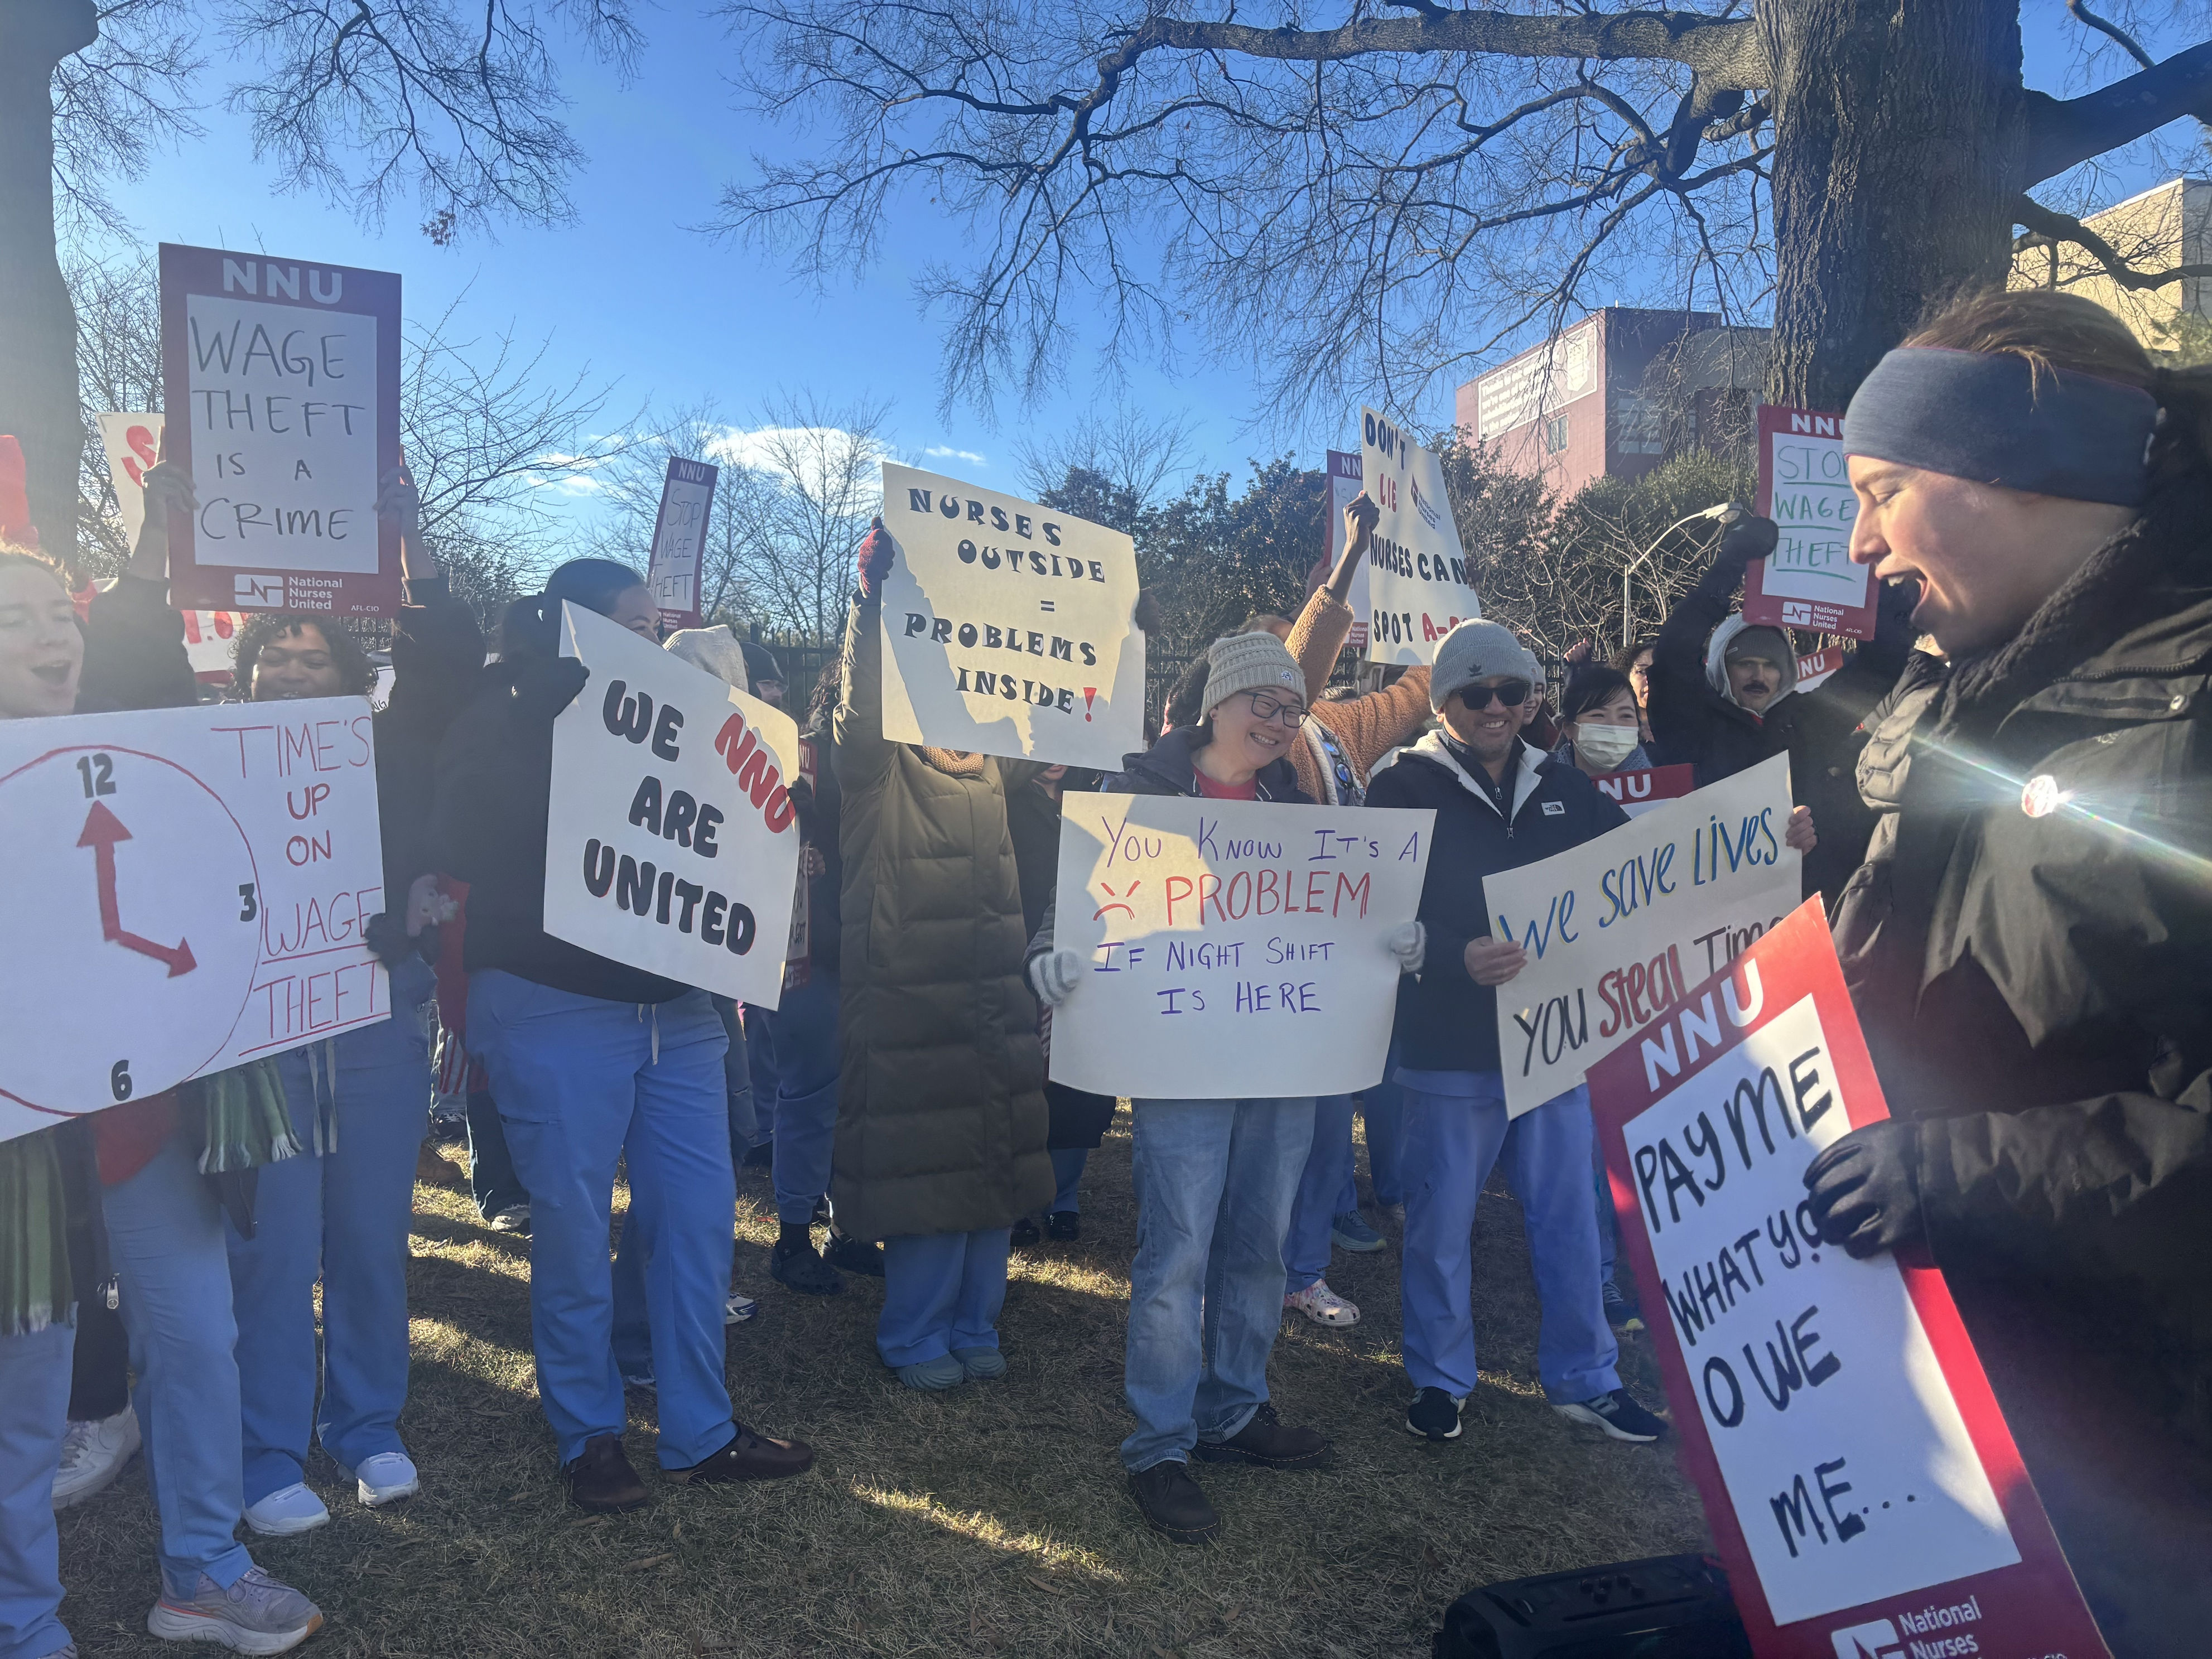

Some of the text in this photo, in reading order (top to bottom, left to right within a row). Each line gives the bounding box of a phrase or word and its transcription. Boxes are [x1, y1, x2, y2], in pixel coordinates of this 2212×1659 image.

[223, 258, 343, 305] NNU
[190, 316, 348, 387] WAGE
[192, 390, 366, 437] THEFT
[1365, 413, 1405, 471] DON'T
[217, 453, 312, 480] IS A
[678, 461, 705, 483] NNU
[1342, 456, 1362, 478] NN
[667, 488, 701, 528] STOP
[1380, 473, 1396, 513] LIE
[1775, 492, 1855, 521] WAGE
[201, 498, 354, 540] CRIME
[908, 489, 1061, 546] NURSES
[1418, 508, 1435, 529] United
[659, 530, 692, 558] WAGE
[958, 539, 1105, 583] OUTSIDE
[1370, 533, 1468, 585] NURSES CAN
[289, 576, 343, 588] National
[289, 588, 332, 599] Nurses
[649, 563, 693, 601] THEFT
[289, 599, 332, 610] United
[1813, 613, 1838, 623] Nurses
[1814, 605, 1844, 616] National
[904, 613, 1096, 665] PROBLEMS
[1374, 609, 1413, 644] SPOT
[1813, 620, 1837, 630] United
[1797, 653, 1825, 679] NU
[955, 667, 1097, 722] INSIDE!
[603, 679, 684, 762] WE
[211, 716, 371, 778] TIME'S
[76, 753, 117, 798] 12
[715, 713, 796, 833] NNU
[1599, 774, 1651, 800] NU
[288, 783, 330, 820] UP
[628, 775, 724, 858] ARE
[286, 830, 331, 866] ON
[1399, 831, 1419, 862] A
[239, 883, 257, 922] 3
[584, 838, 756, 956] UNITED
[1166, 869, 1371, 927] PROBLEM
[1497, 890, 1579, 959] We
[1599, 842, 1676, 929] save
[264, 887, 382, 957] WAGE
[1094, 937, 1335, 972] IF NIGHT SHIFT
[253, 960, 381, 1039] THEFT
[1157, 981, 1321, 1015] IS HERE
[1640, 957, 1763, 1093] NNU
[111, 1059, 132, 1101] 6
[1662, 1199, 1824, 1346] WHAT YO
[1703, 1305, 1842, 1428] OWE
[1898, 1595, 1982, 1636] National
[1909, 1633, 1979, 1659] Nurses
